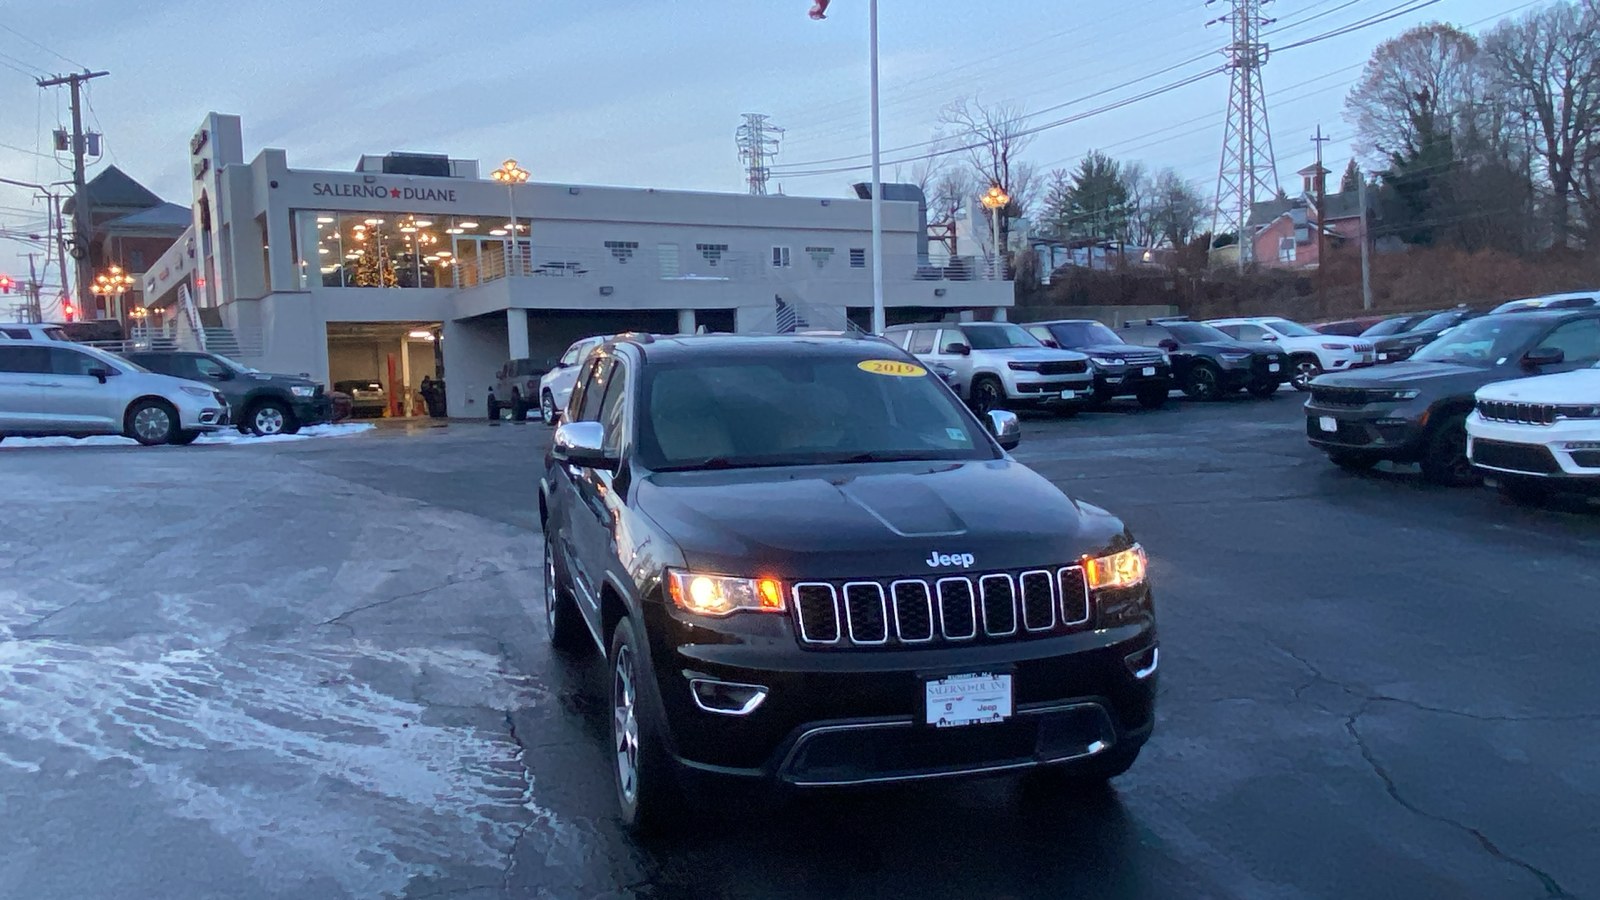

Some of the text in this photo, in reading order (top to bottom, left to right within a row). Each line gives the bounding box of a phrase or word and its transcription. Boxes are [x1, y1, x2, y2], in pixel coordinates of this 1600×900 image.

[312, 183, 457, 202] SALERNO DUANE
[873, 362, 915, 374] 2019
[926, 551, 975, 568] Jeep
[977, 704, 997, 712] Jeep
